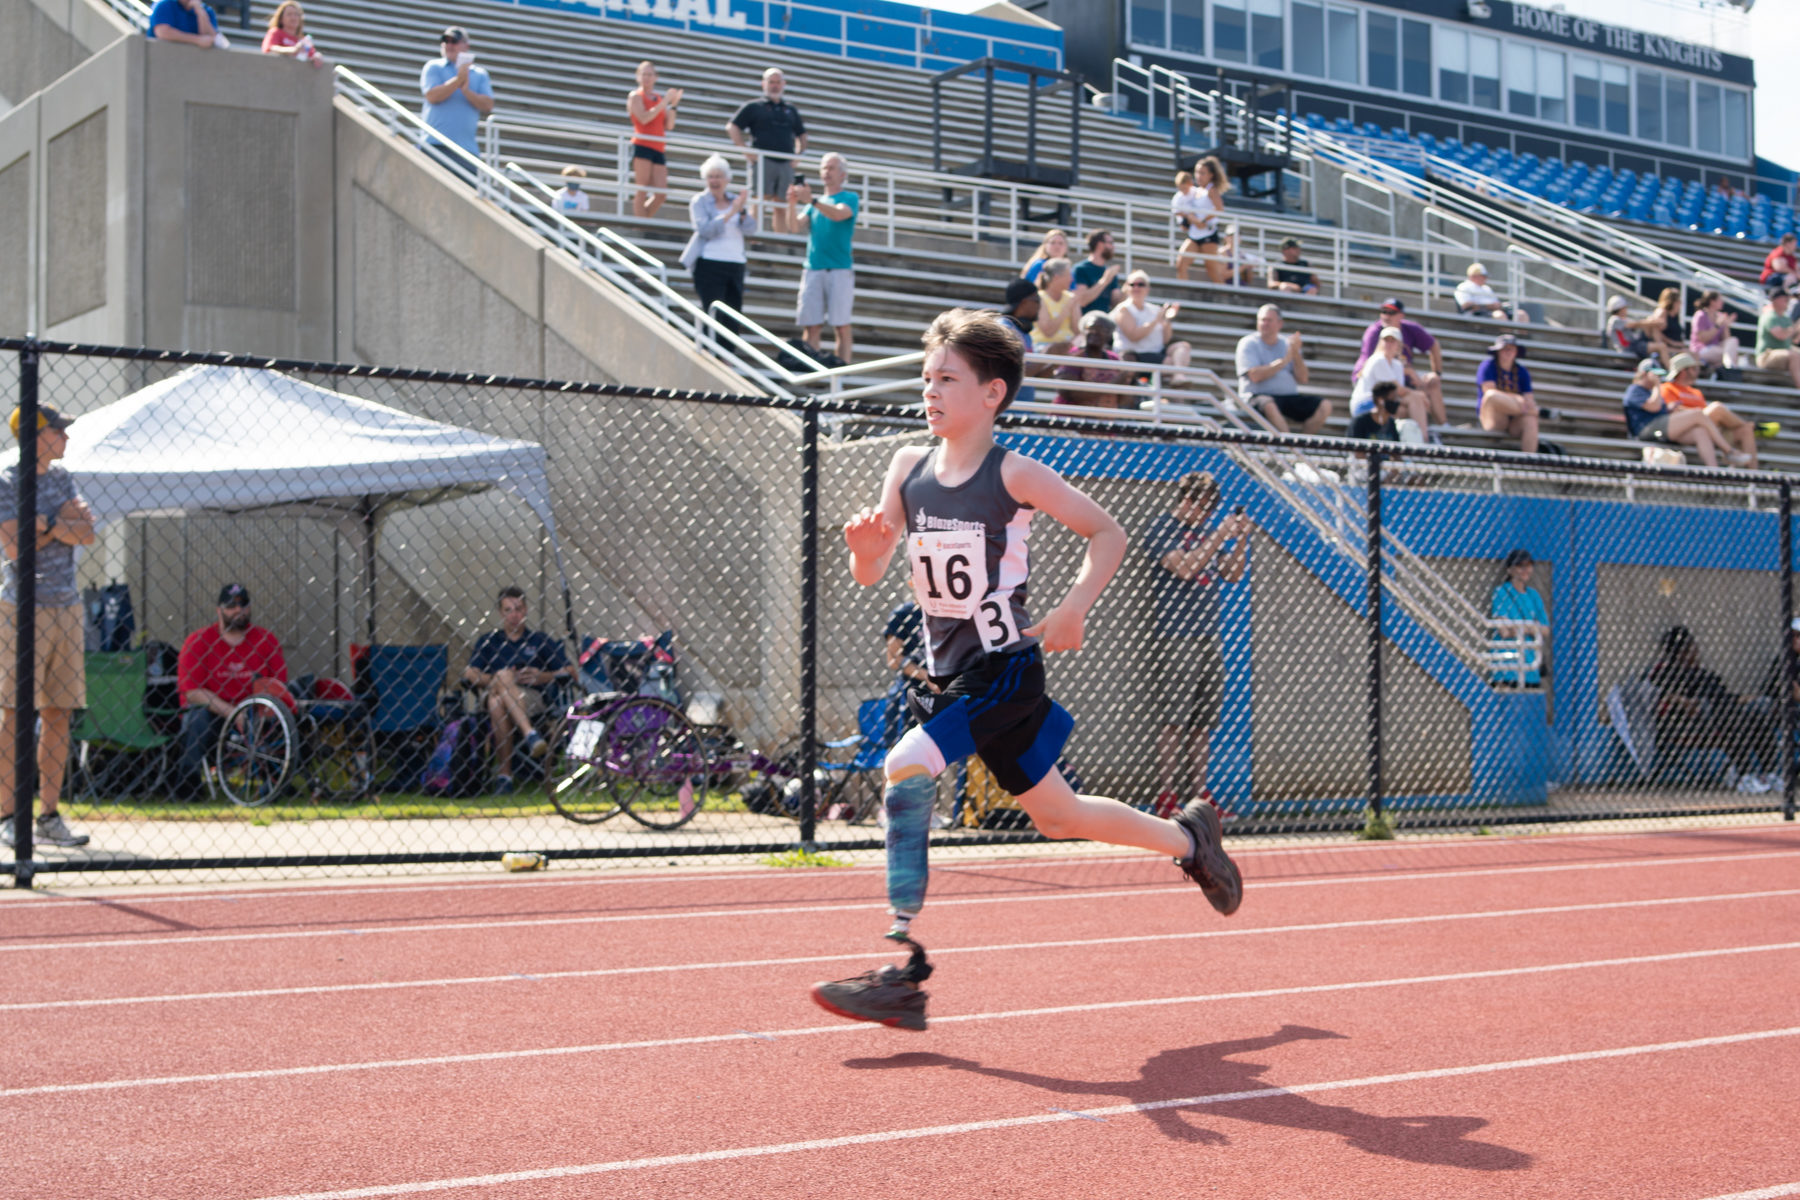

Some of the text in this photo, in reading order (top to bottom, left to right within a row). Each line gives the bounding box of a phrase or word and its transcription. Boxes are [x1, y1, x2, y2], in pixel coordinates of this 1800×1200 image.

[1512, 4, 1723, 71] HOME OF THE KNIGHTS
[919, 554, 972, 600] 16
[980, 601, 1009, 647] 3
